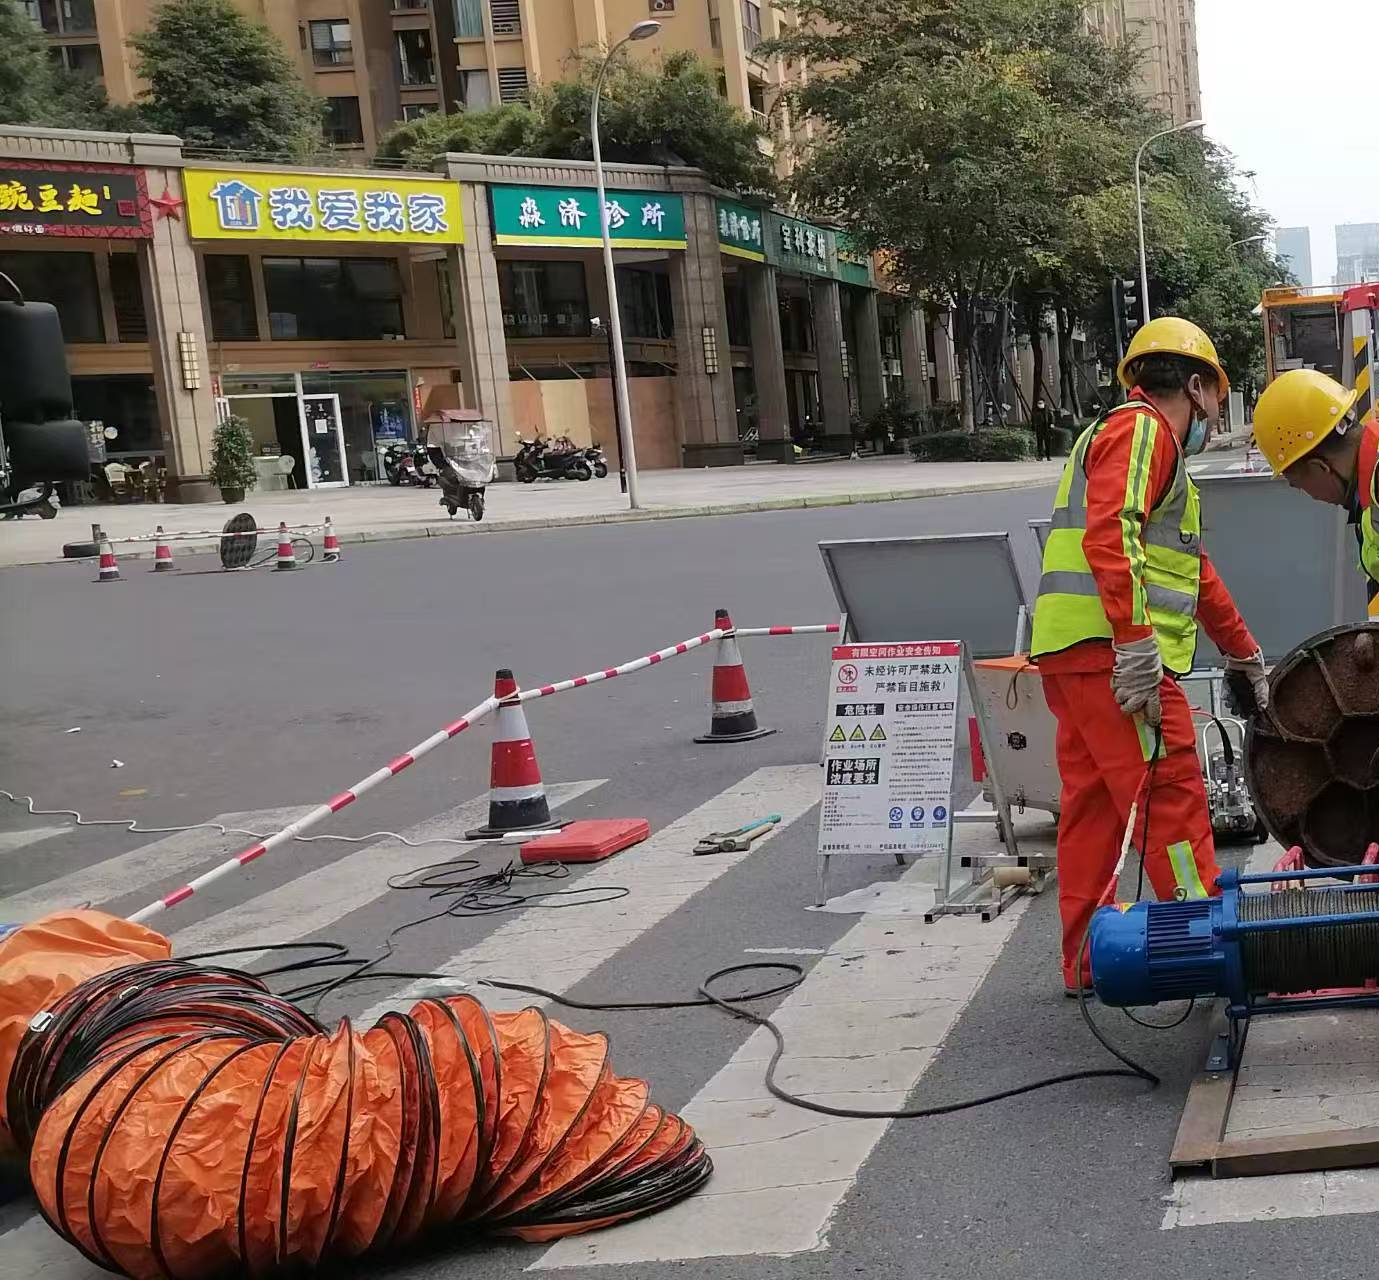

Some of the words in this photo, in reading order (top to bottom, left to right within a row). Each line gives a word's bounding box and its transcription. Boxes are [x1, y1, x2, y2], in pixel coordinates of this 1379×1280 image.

[269, 188, 448, 233] 我爱我家
[519, 196, 666, 233] 淼济诊所
[851, 645, 942, 658] 有限空间作业安全告知
[844, 703, 878, 716] 危险性
[831, 758, 878, 772] 作业场所
[830, 772, 877, 785] 浓度要求
